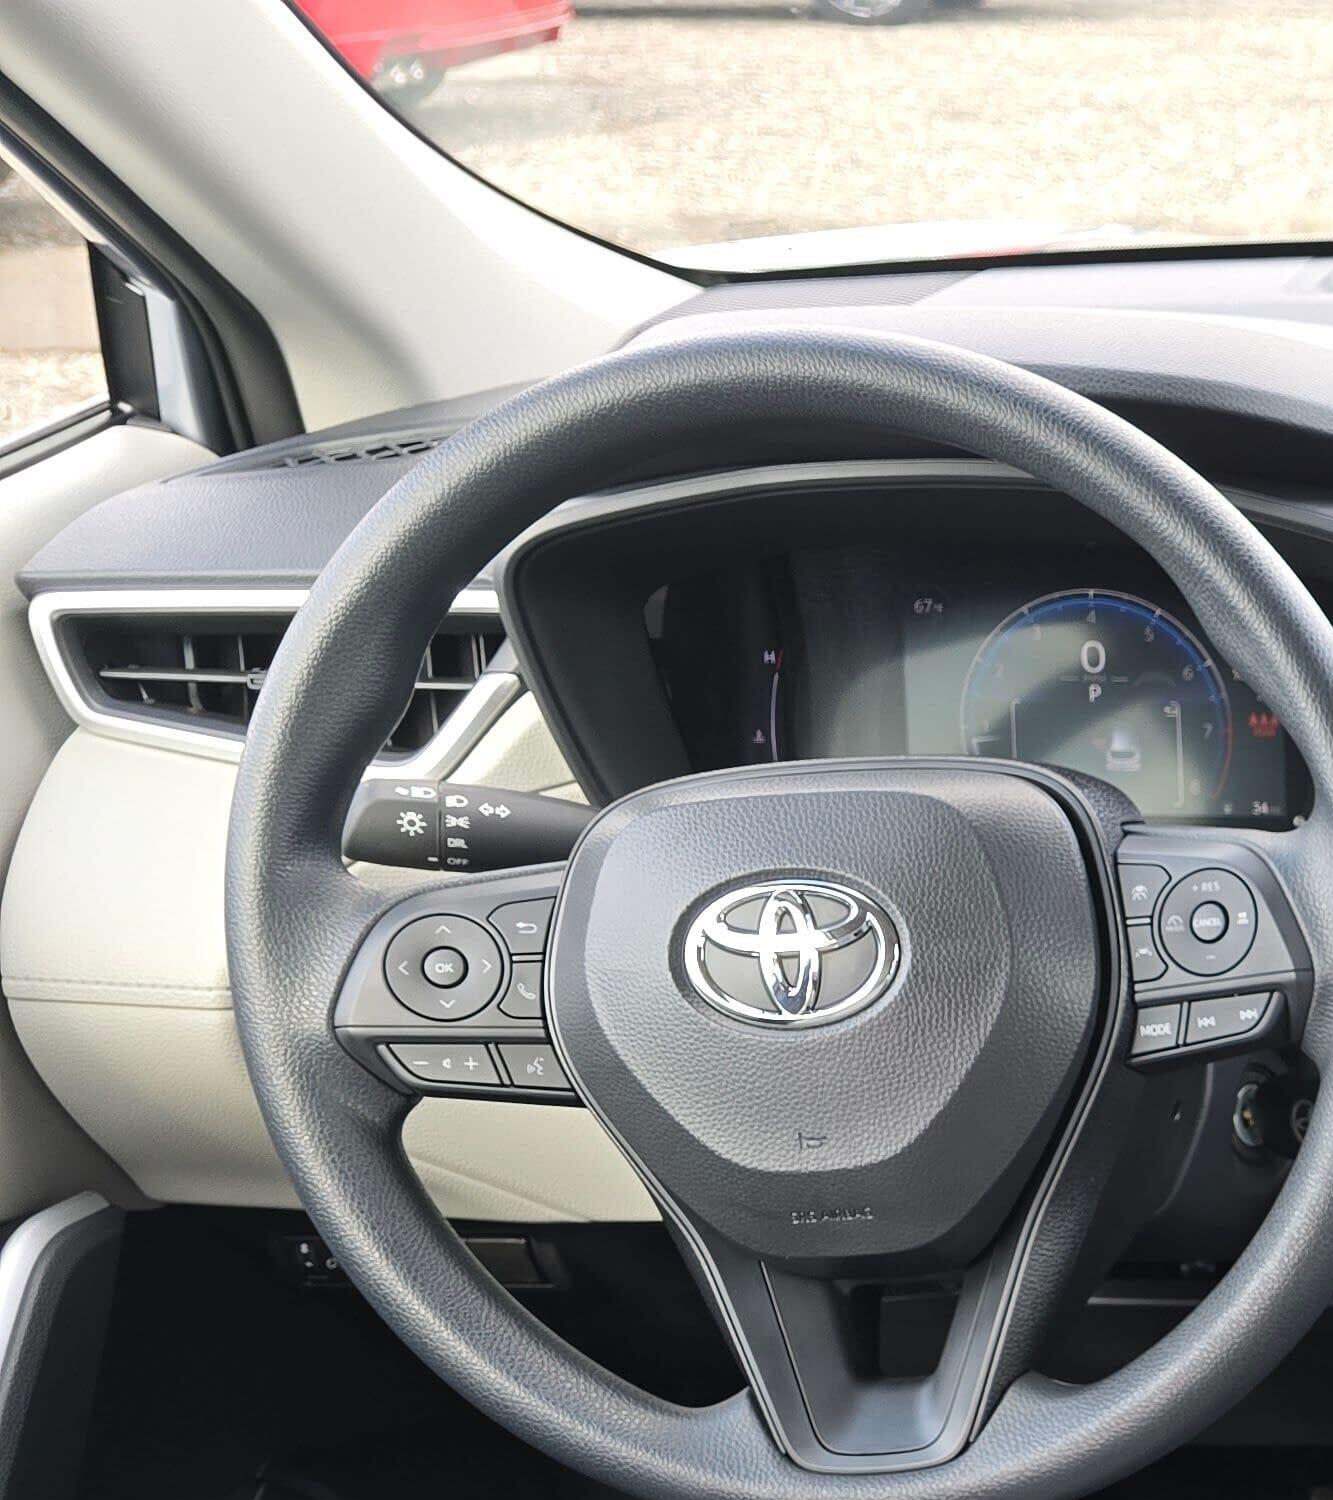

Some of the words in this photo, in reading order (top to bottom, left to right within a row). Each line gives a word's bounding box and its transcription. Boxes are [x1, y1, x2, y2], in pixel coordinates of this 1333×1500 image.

[1080, 639, 1107, 674] 0
[1088, 683, 1102, 702] P
[435, 962, 454, 974] OK
[1139, 1022, 1173, 1037] MODE
